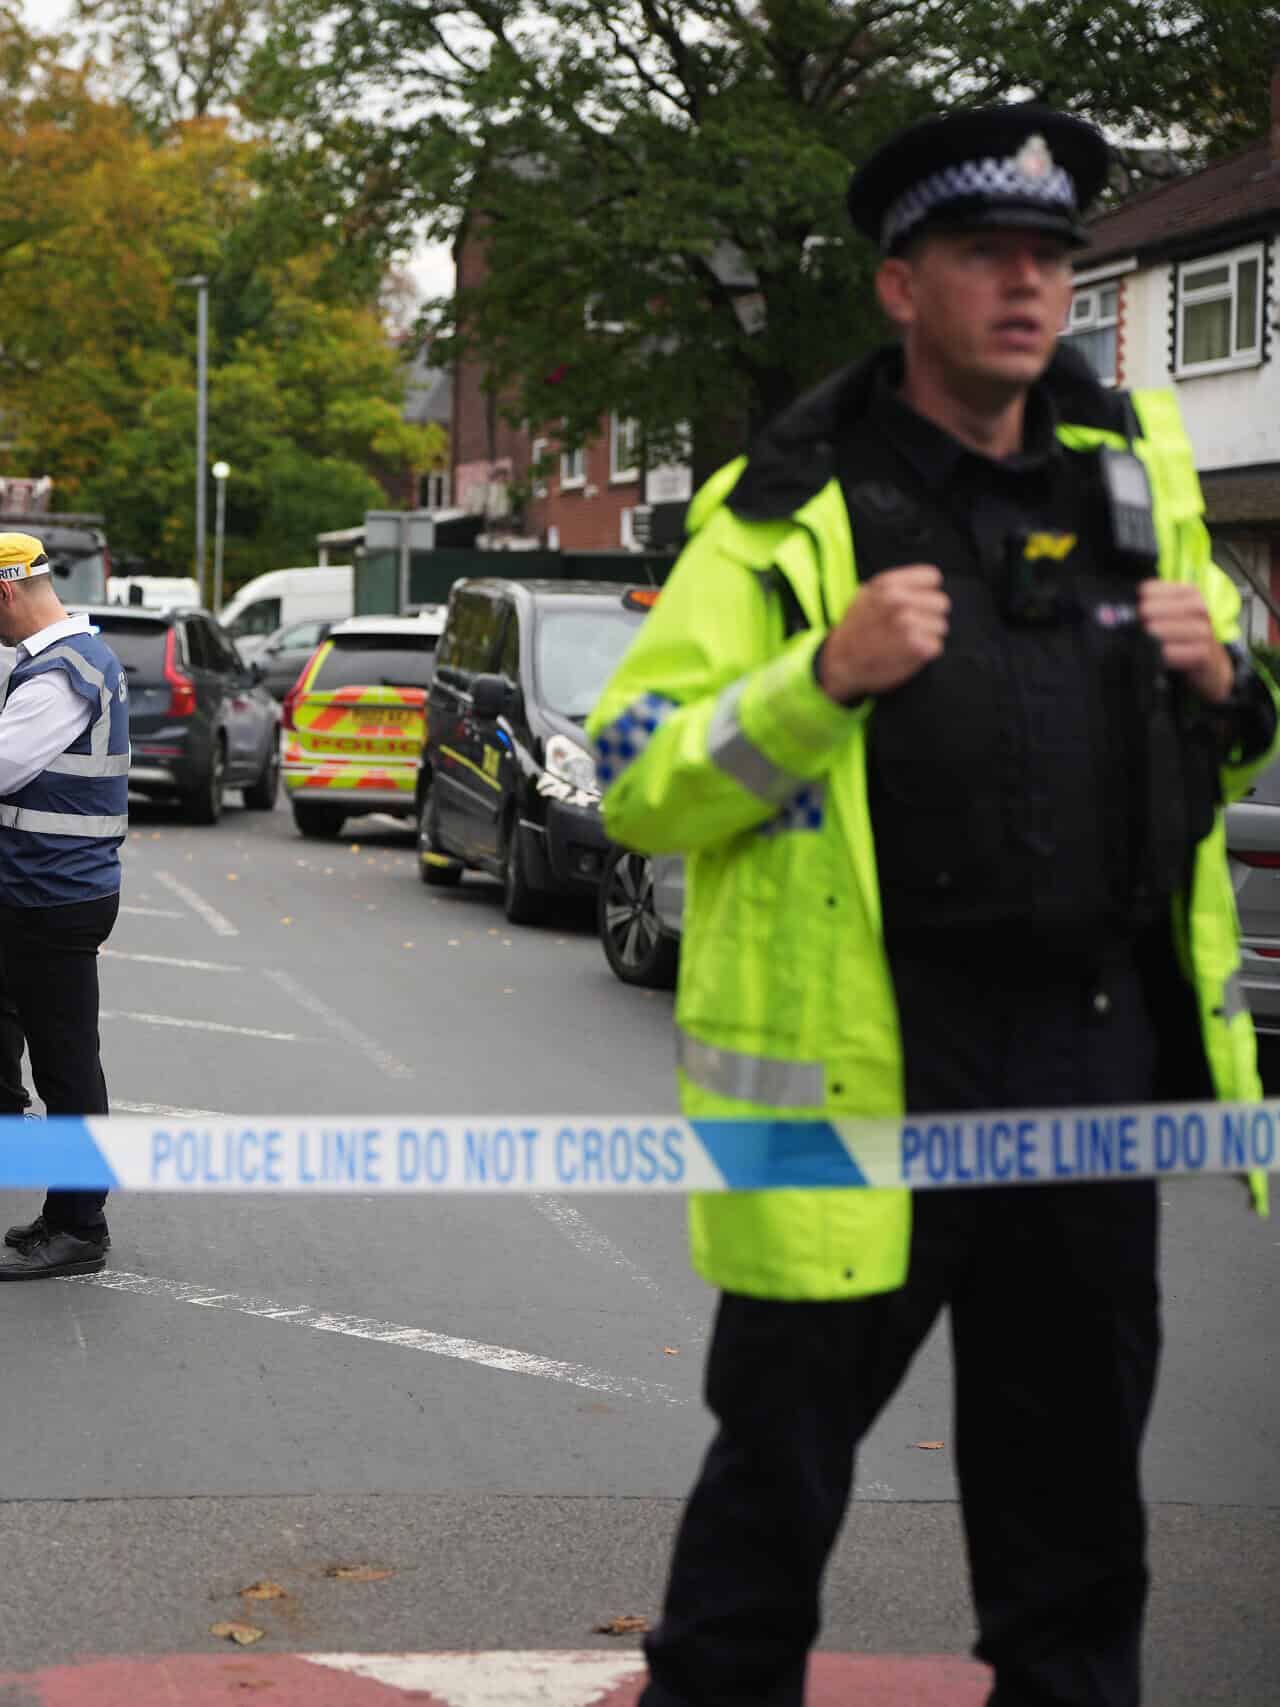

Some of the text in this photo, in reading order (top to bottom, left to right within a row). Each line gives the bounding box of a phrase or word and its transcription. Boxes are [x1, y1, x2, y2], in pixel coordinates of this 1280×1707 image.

[311, 737, 420, 753] POLIC
[151, 1128, 686, 1183] POLICE LINE DO NOT CROSS
[900, 1106, 1280, 1182] POLICE LINE DO NO
